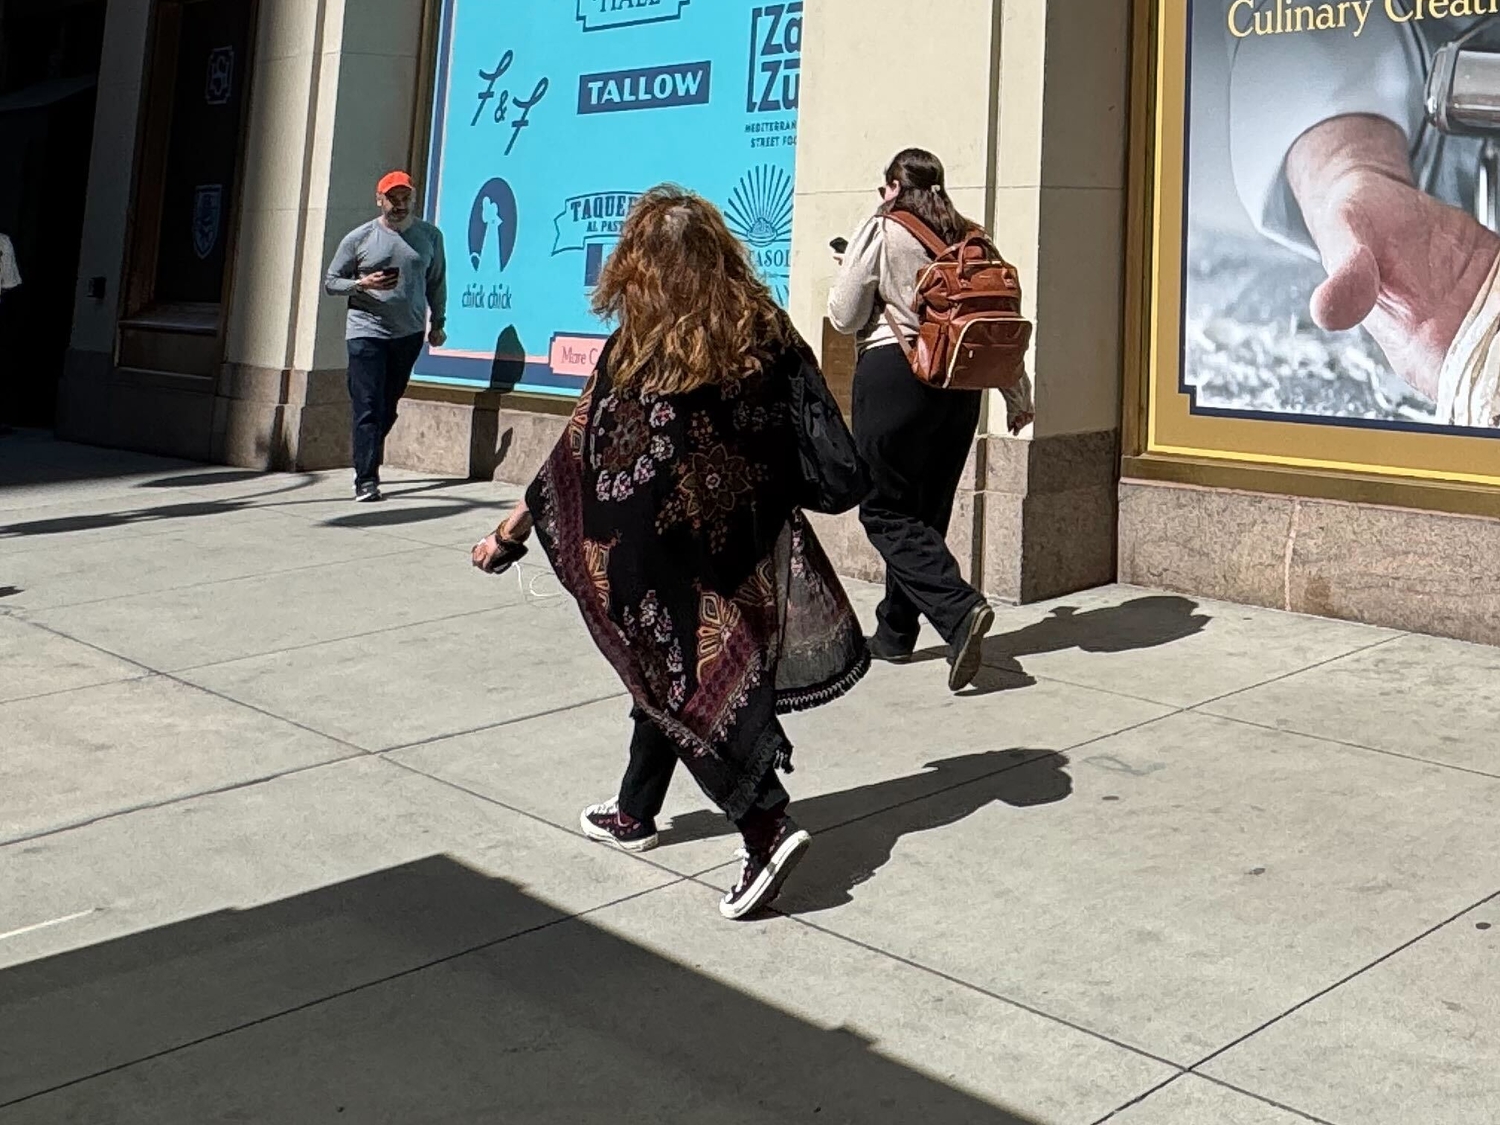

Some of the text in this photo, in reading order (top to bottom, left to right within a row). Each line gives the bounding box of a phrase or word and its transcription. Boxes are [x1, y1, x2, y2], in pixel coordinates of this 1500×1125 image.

[587, 70, 703, 105] TALLOW
[751, 136, 780, 148] STREET
[586, 221, 599, 232] AL
[561, 346, 587, 365] More
